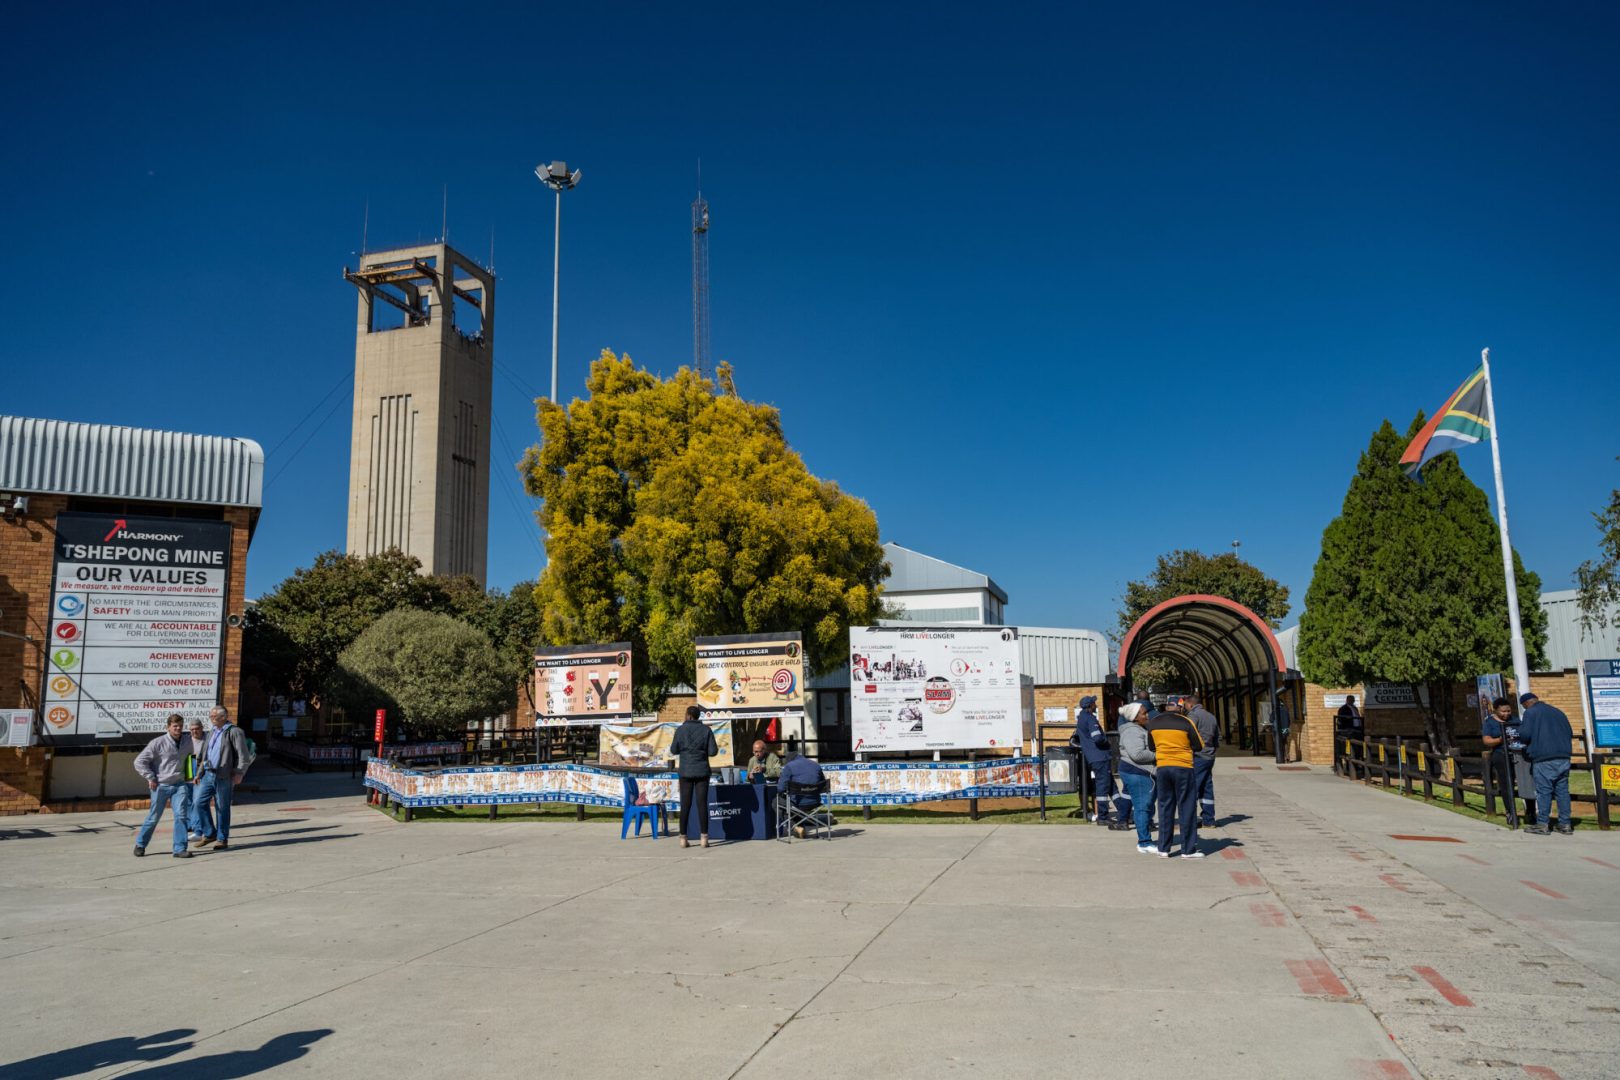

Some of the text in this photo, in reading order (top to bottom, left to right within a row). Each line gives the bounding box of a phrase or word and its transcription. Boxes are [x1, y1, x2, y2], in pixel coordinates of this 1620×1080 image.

[118, 530, 180, 542] HARMONY
[62, 544, 224, 564] TSHEPONG MINE
[76, 566, 207, 585] OUR VALUES
[154, 600, 219, 608] CIRCUMSTANCES,
[150, 623, 217, 631] ACCOUNTABLE
[590, 679, 618, 710] Y
